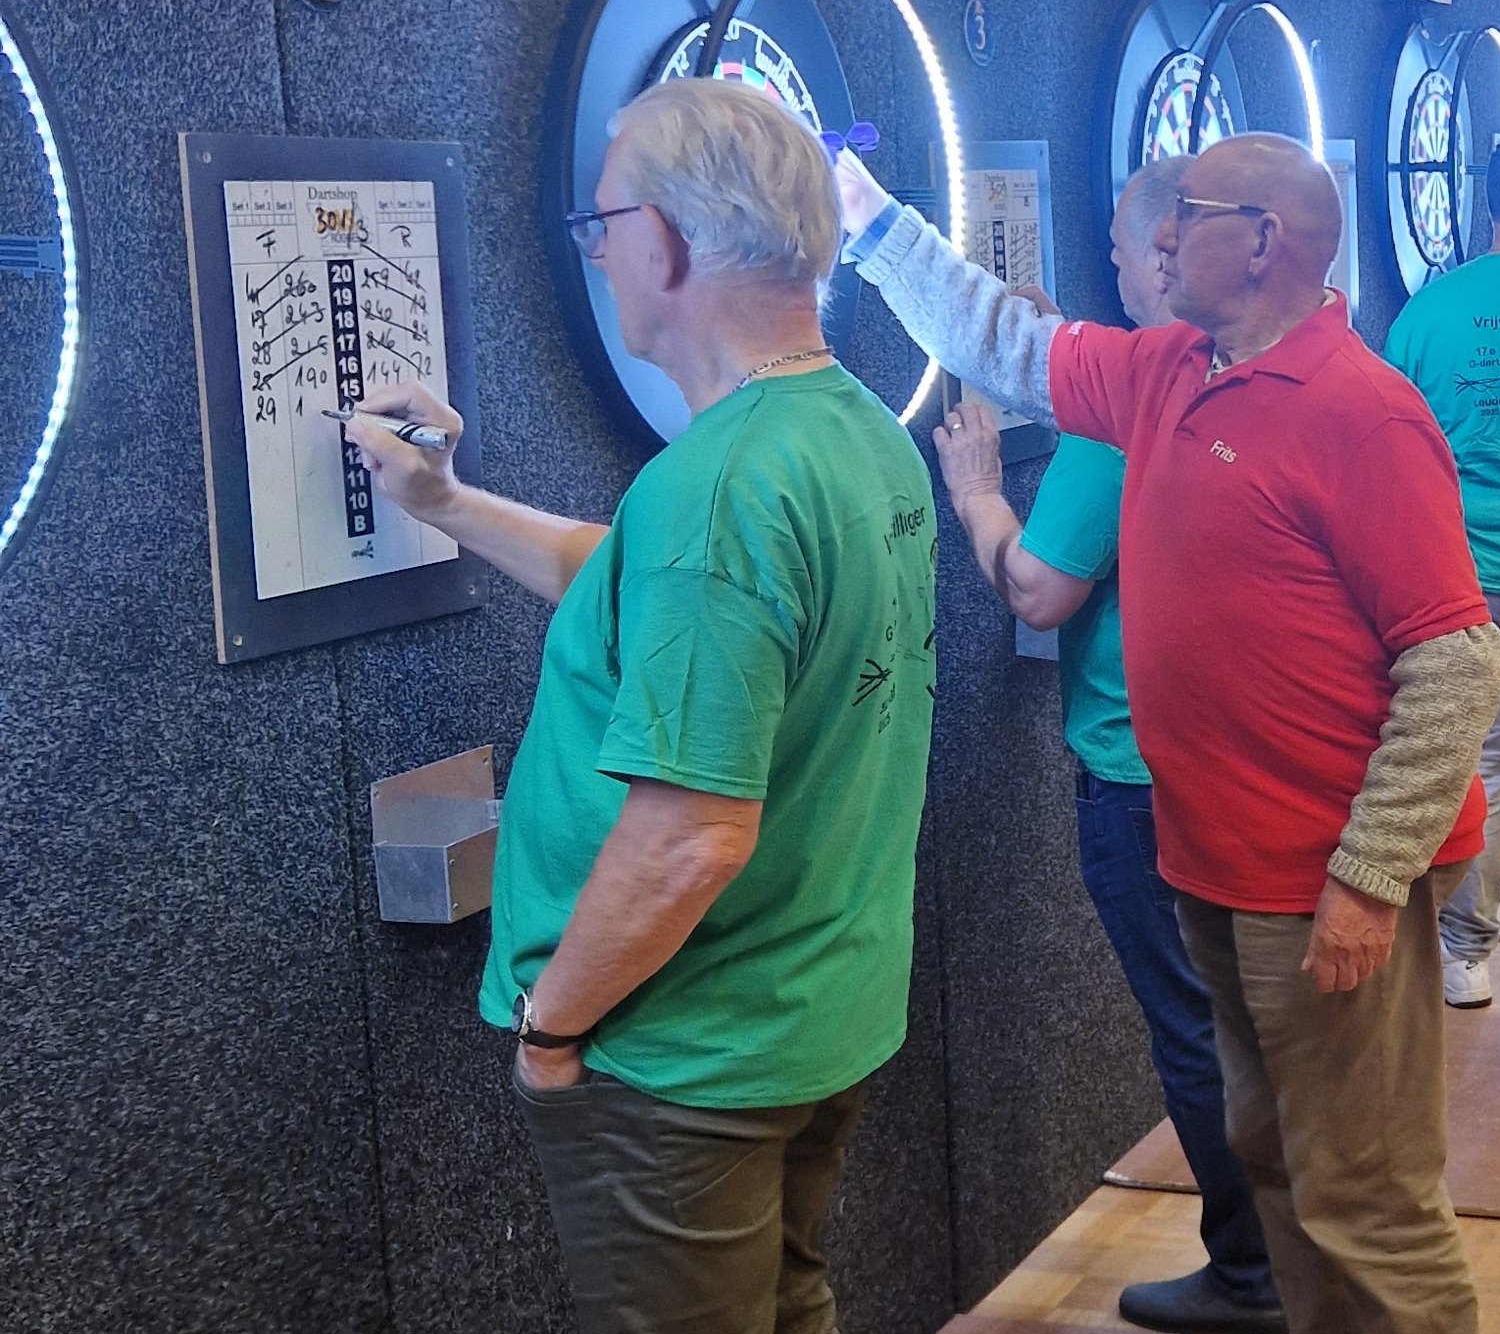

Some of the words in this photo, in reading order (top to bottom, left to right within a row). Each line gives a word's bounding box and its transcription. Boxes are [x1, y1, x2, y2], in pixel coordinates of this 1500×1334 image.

[975, 15, 986, 50] 3
[308, 185, 358, 201] Dartshop
[232, 202, 244, 210] Set
[254, 202, 265, 210] Set
[276, 202, 287, 210] Set
[390, 225, 413, 248] R
[331, 265, 353, 283] 20
[284, 270, 317, 298] 260
[333, 287, 353, 306] 19
[286, 301, 325, 325] 243
[335, 310, 355, 329] 18
[365, 299, 392, 321] 240
[252, 340, 271, 365] 28
[291, 335, 327, 356] 215
[337, 334, 356, 352] 17
[1475, 347, 1488, 356] 17
[338, 356, 359, 375] 16
[366, 360, 400, 385] 144
[410, 351, 432, 381] 72
[295, 365, 327, 389] 190
[340, 379, 361, 398] 15
[256, 395, 276, 425] 29
[296, 395, 303, 417] 1
[347, 469, 366, 488] 11
[349, 492, 368, 511] 10
[354, 515, 367, 533] B
